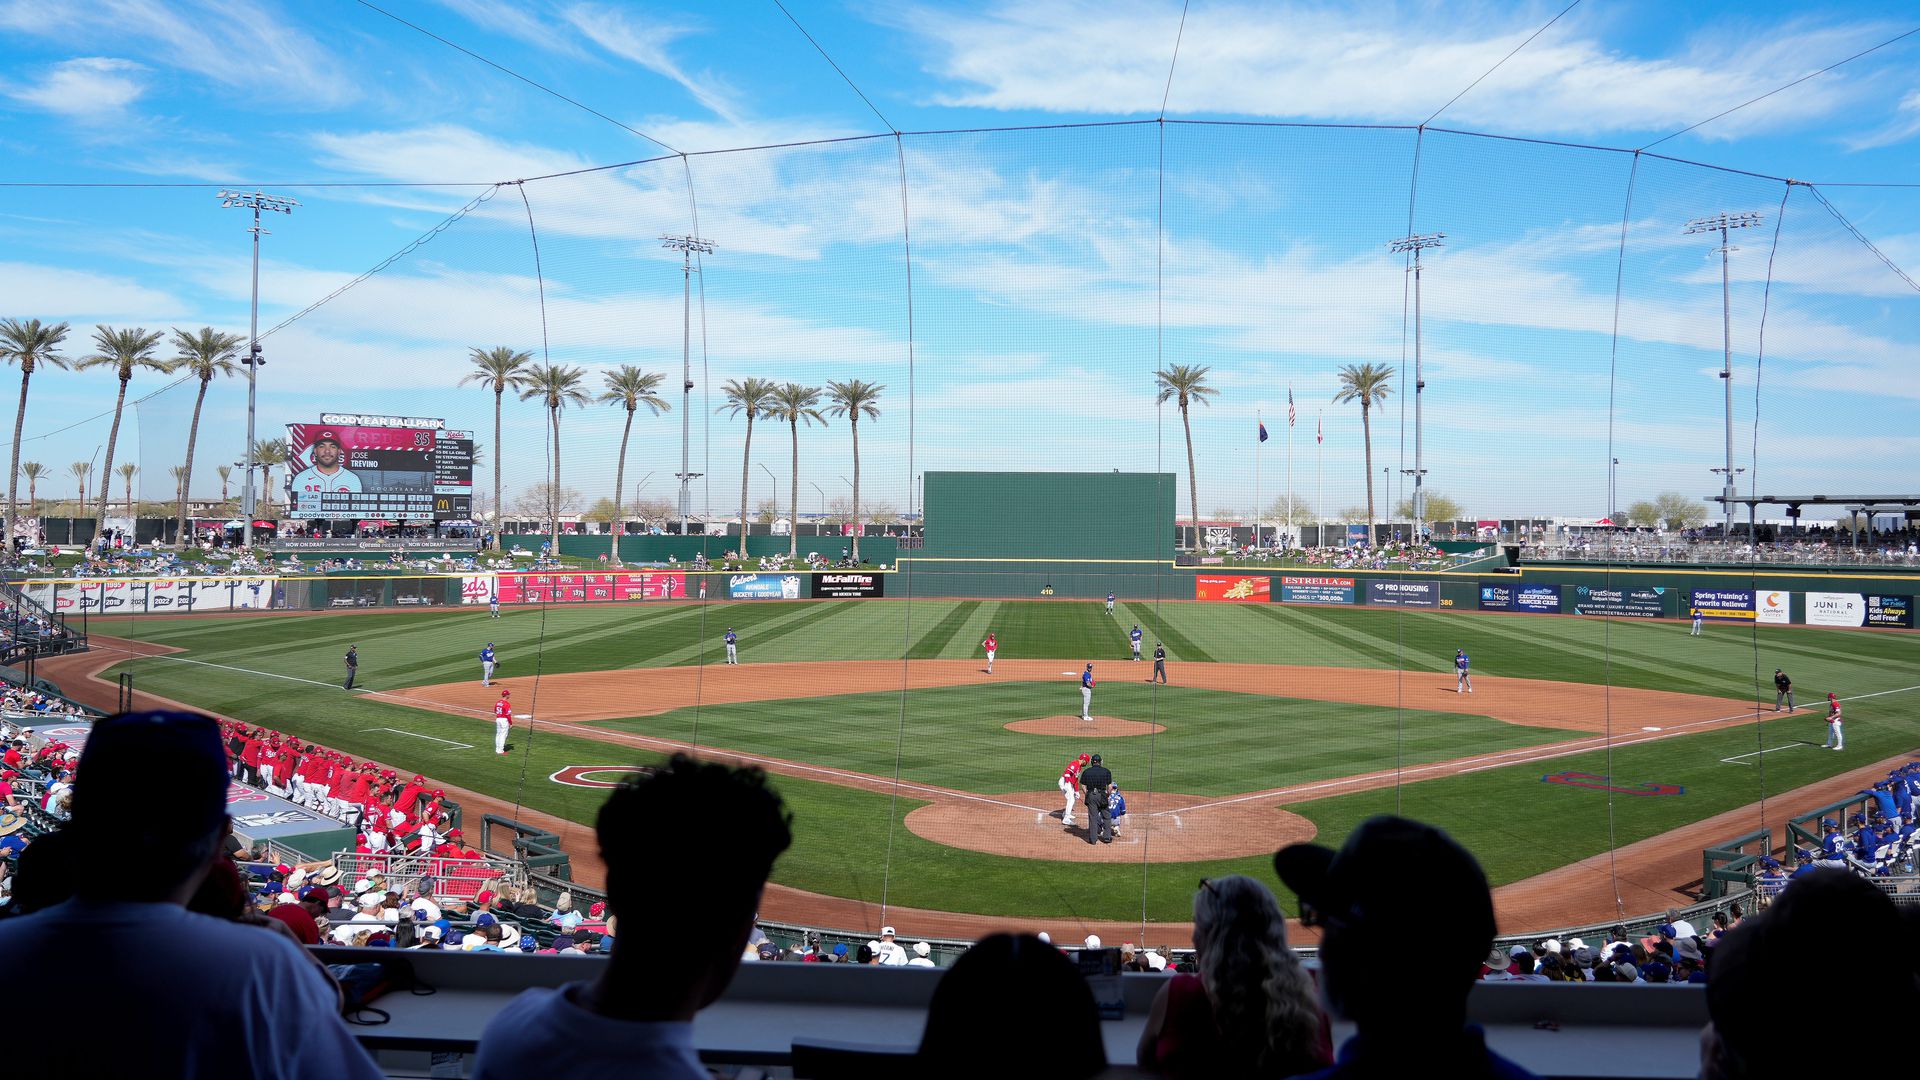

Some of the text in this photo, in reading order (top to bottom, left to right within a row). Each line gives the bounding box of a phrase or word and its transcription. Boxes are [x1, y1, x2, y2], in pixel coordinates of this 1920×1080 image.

[322, 415, 444, 428] GOODYEAR BALLPARK
[414, 432, 430, 446] 35
[463, 577, 488, 596] eds
